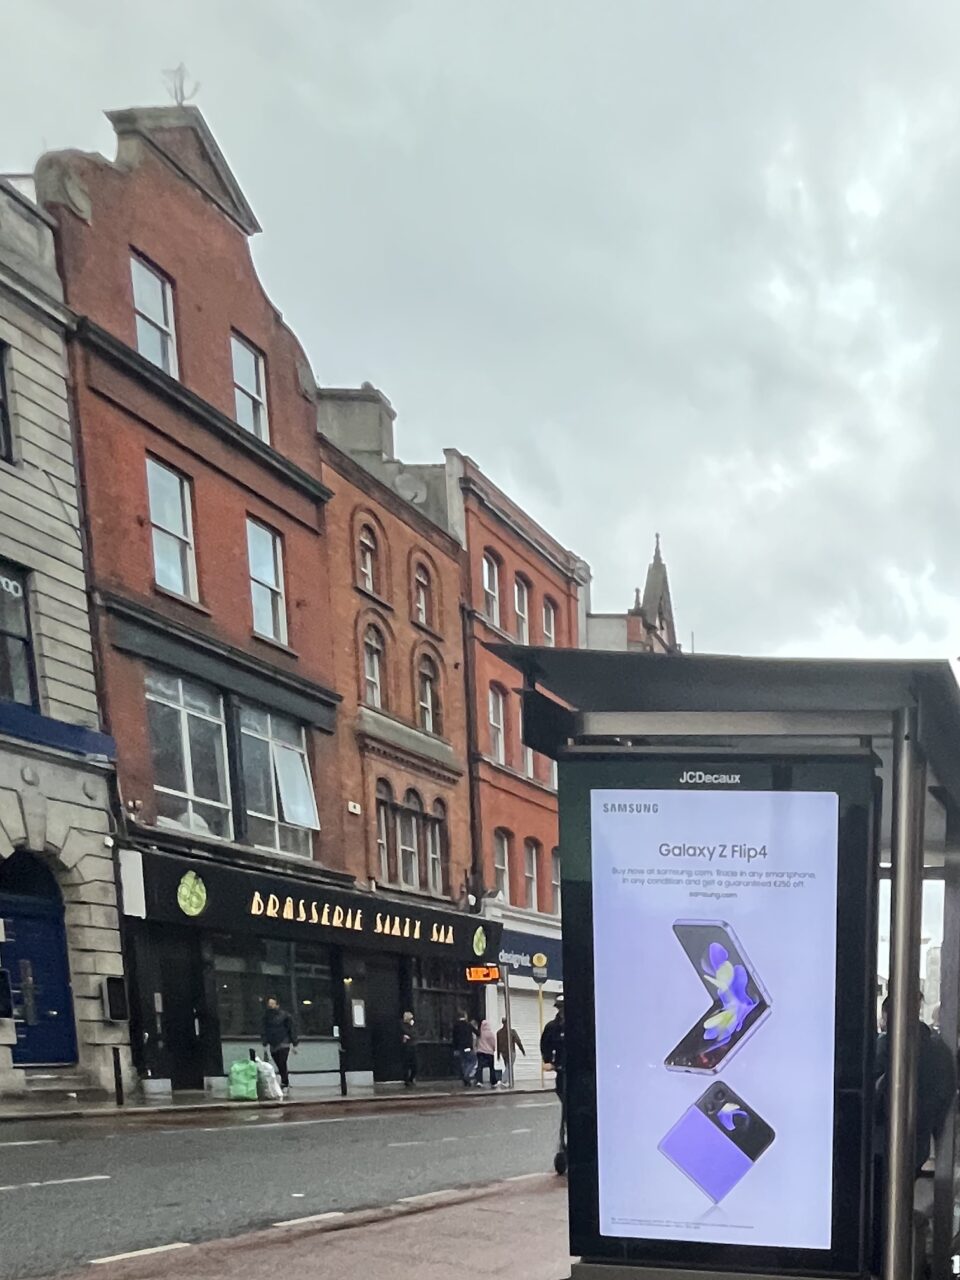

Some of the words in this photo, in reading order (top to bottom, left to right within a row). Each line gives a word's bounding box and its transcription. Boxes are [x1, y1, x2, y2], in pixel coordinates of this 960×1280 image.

[679, 771, 741, 784] JCDecaux
[603, 803, 659, 814] SAMSUNG
[658, 843, 716, 862] Galaxy
[719, 844, 727, 859] Z
[731, 845, 768, 863] Flip4
[612, 867, 626, 876] Buy
[748, 871, 763, 879] any
[702, 879, 716, 888] get
[689, 891, 738, 900] samsung.com
[251, 891, 363, 931] BRASSERIE
[374, 912, 421, 939] SIXTY
[430, 922, 455, 944] SIX
